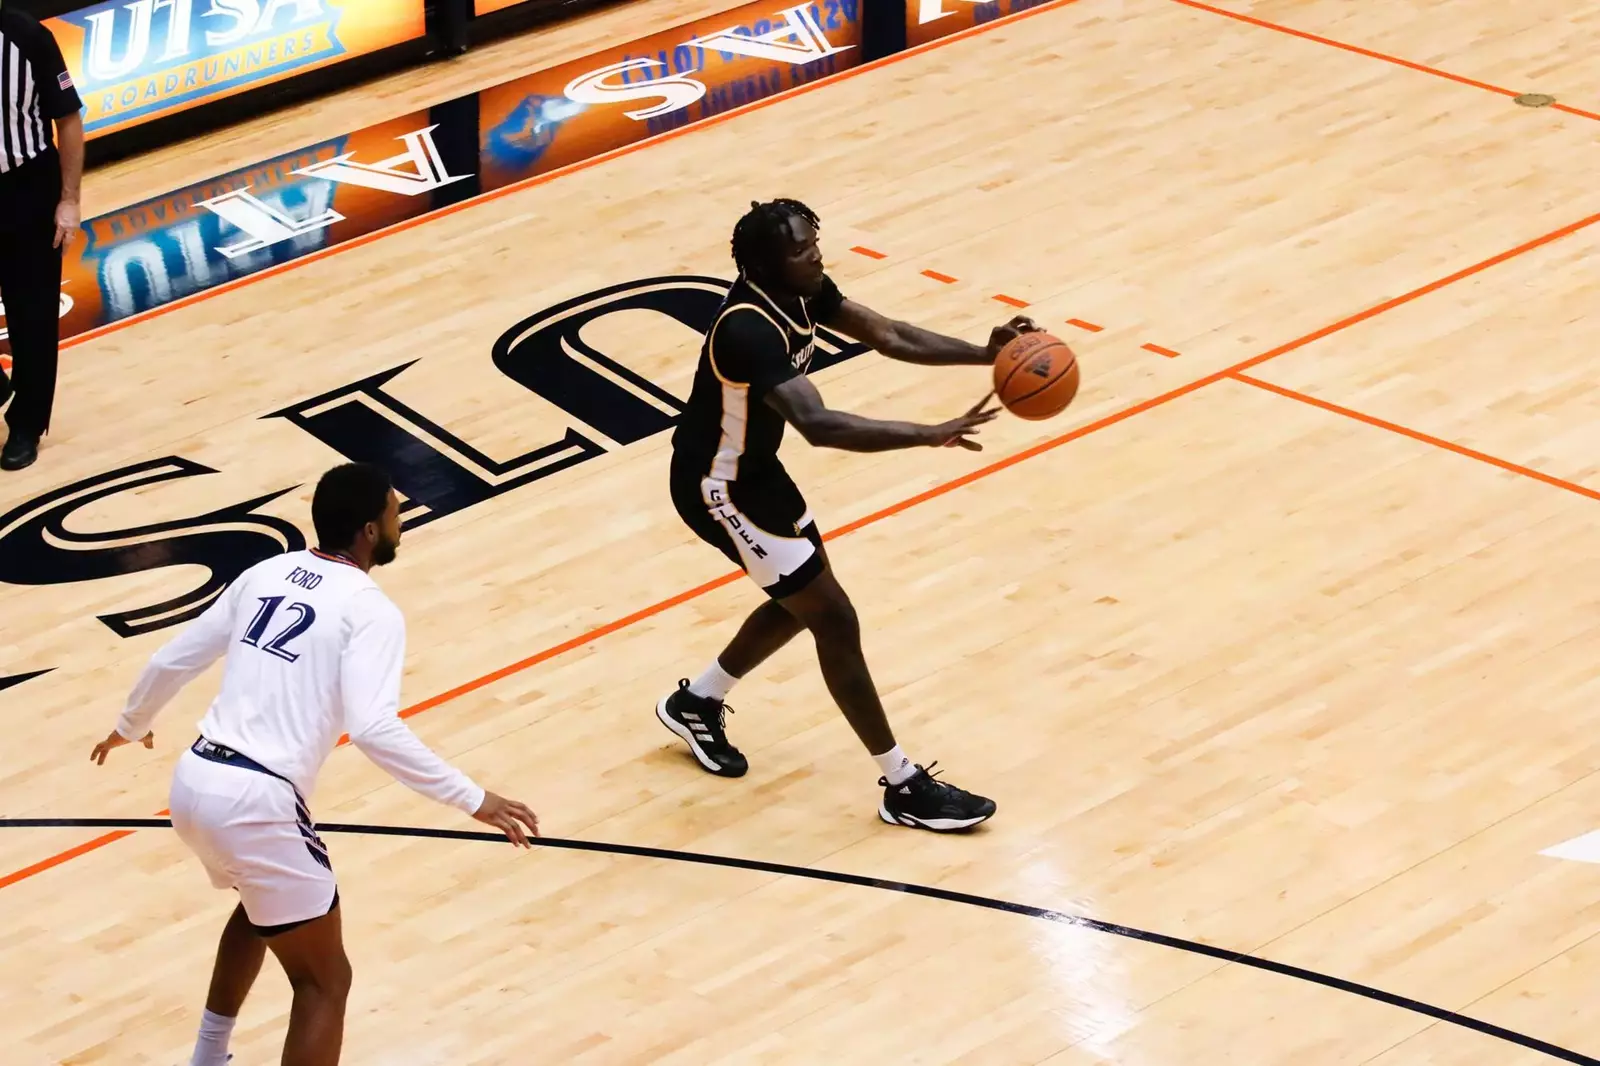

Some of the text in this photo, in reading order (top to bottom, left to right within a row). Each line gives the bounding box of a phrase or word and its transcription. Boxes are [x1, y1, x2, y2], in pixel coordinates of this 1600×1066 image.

[101, 31, 314, 112] ROADRUNNERS
[709, 488, 769, 560] GLDEN
[284, 565, 323, 591] FORD
[239, 595, 317, 664] 12
